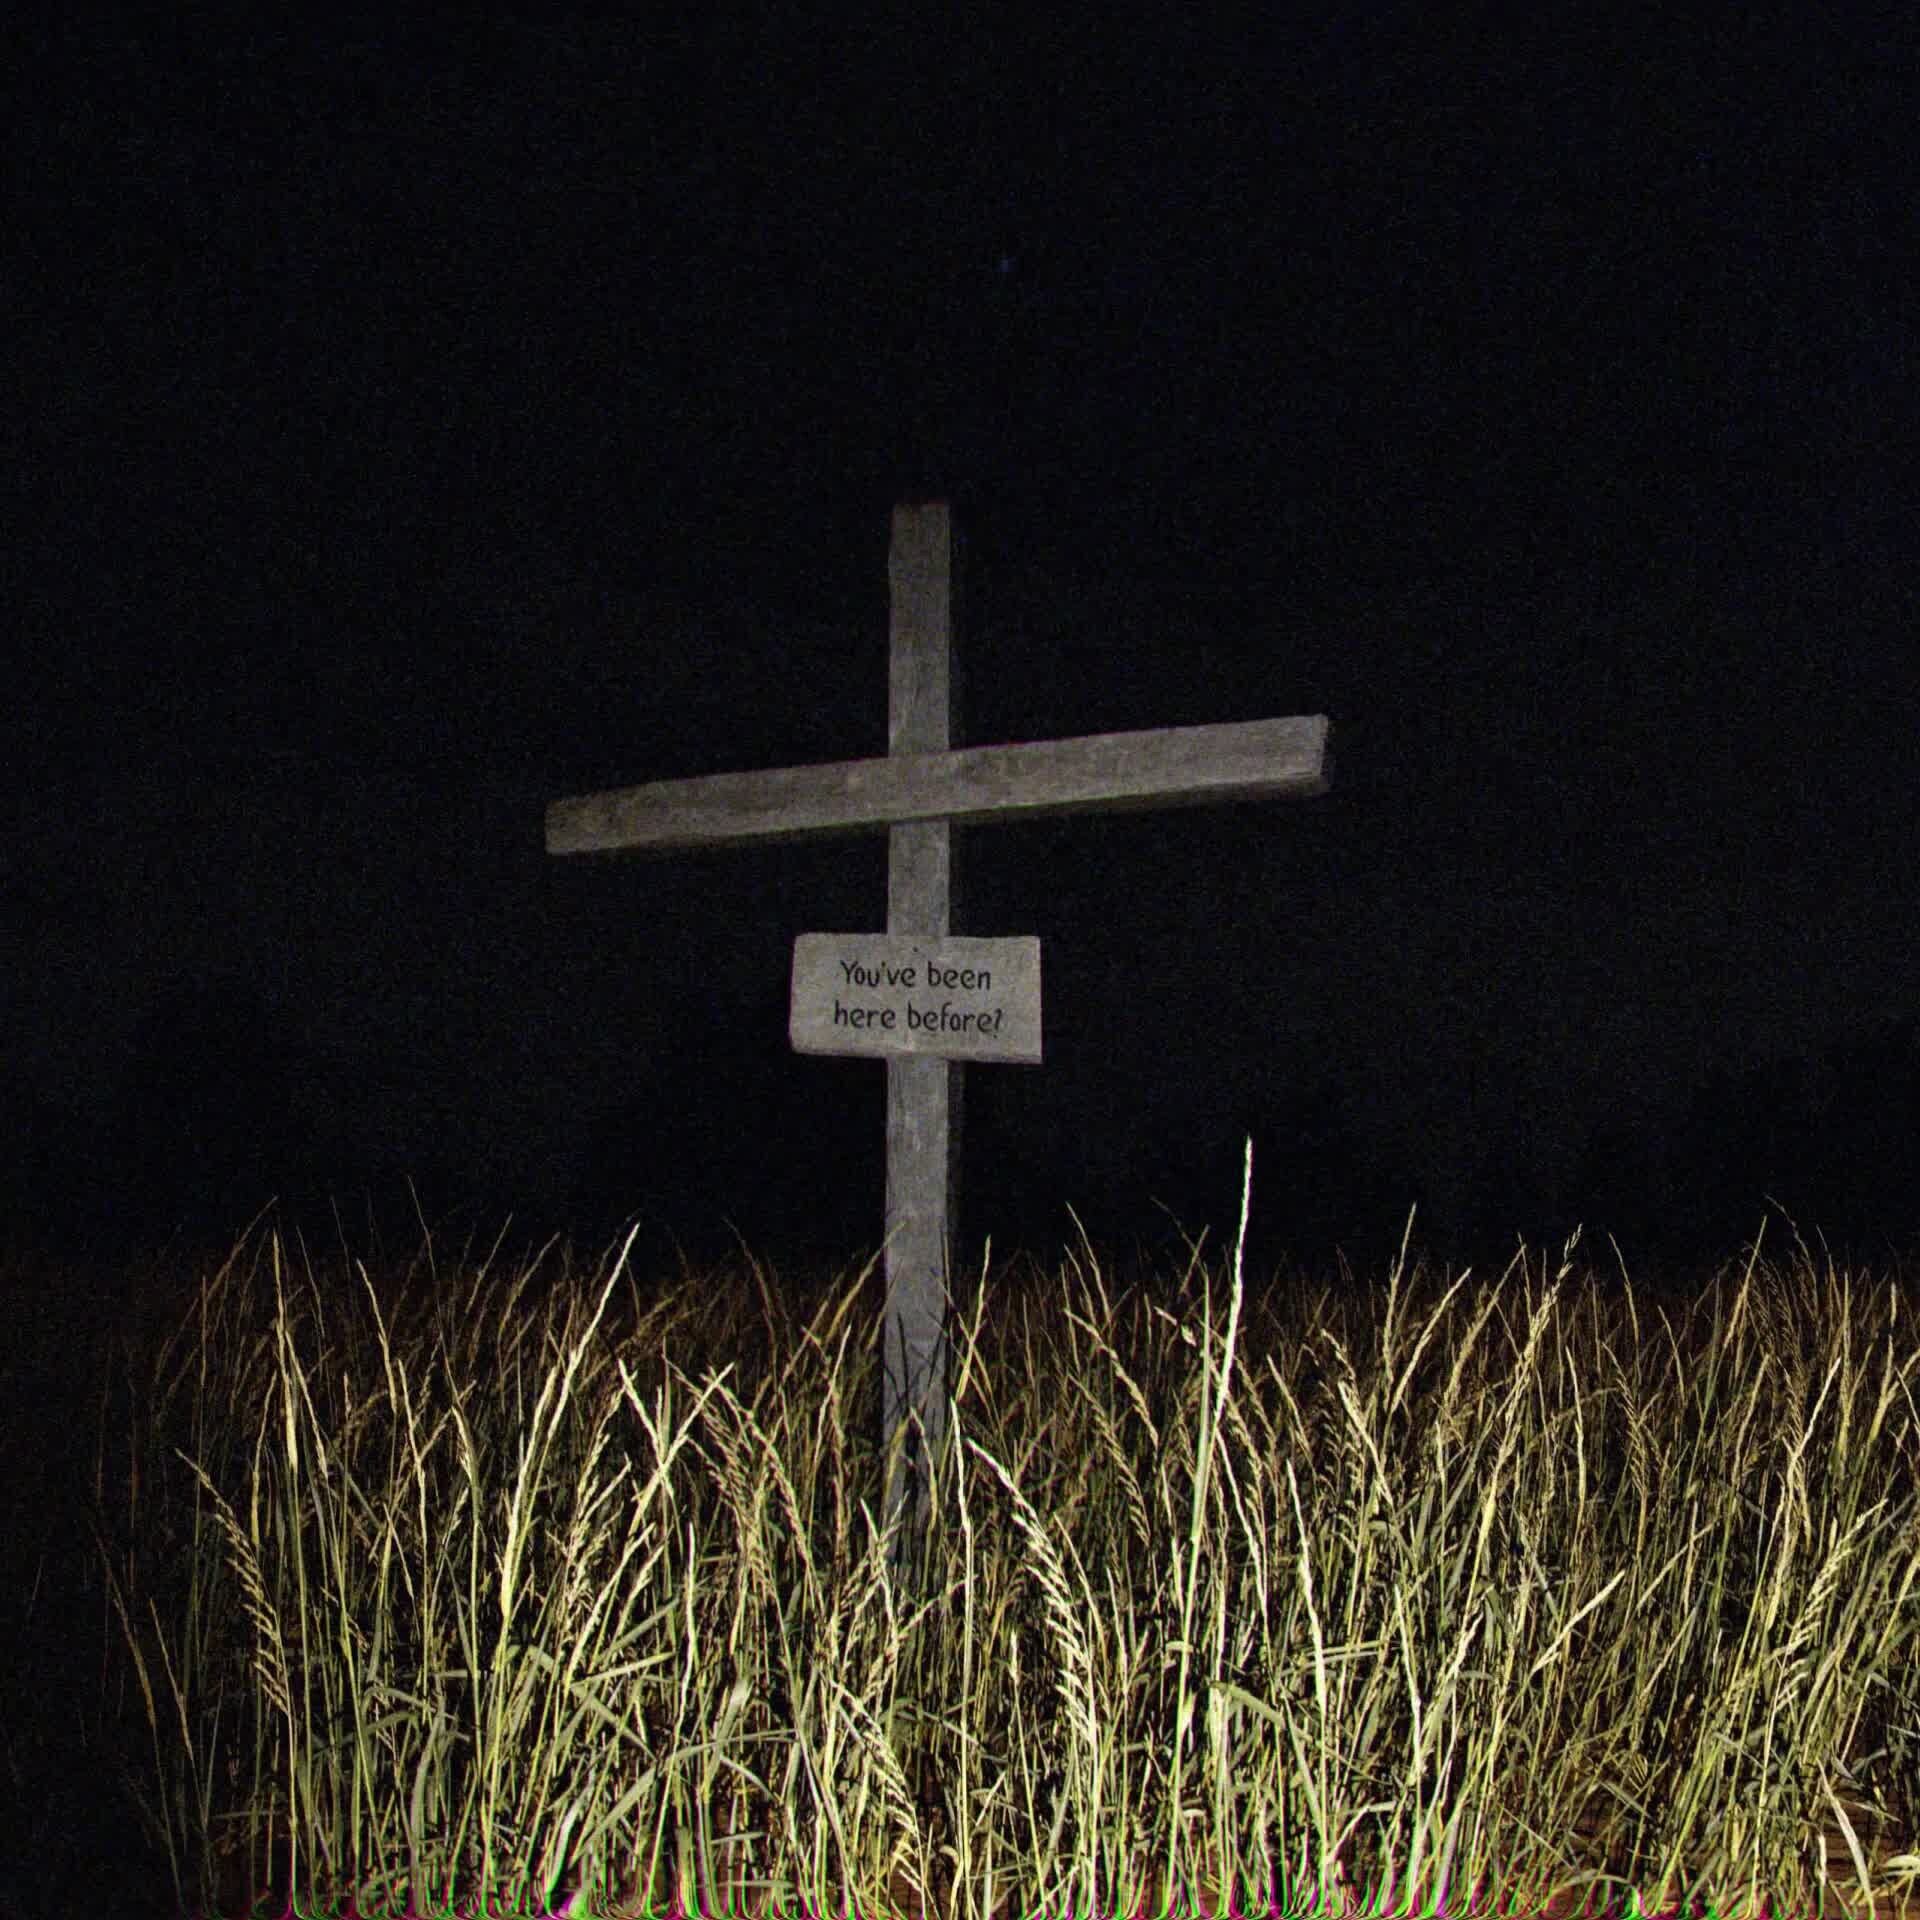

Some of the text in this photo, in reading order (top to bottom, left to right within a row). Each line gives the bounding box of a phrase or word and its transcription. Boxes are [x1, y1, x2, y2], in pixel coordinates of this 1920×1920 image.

[840, 960, 991, 991] You've been
[833, 999, 1003, 1038] here before?
